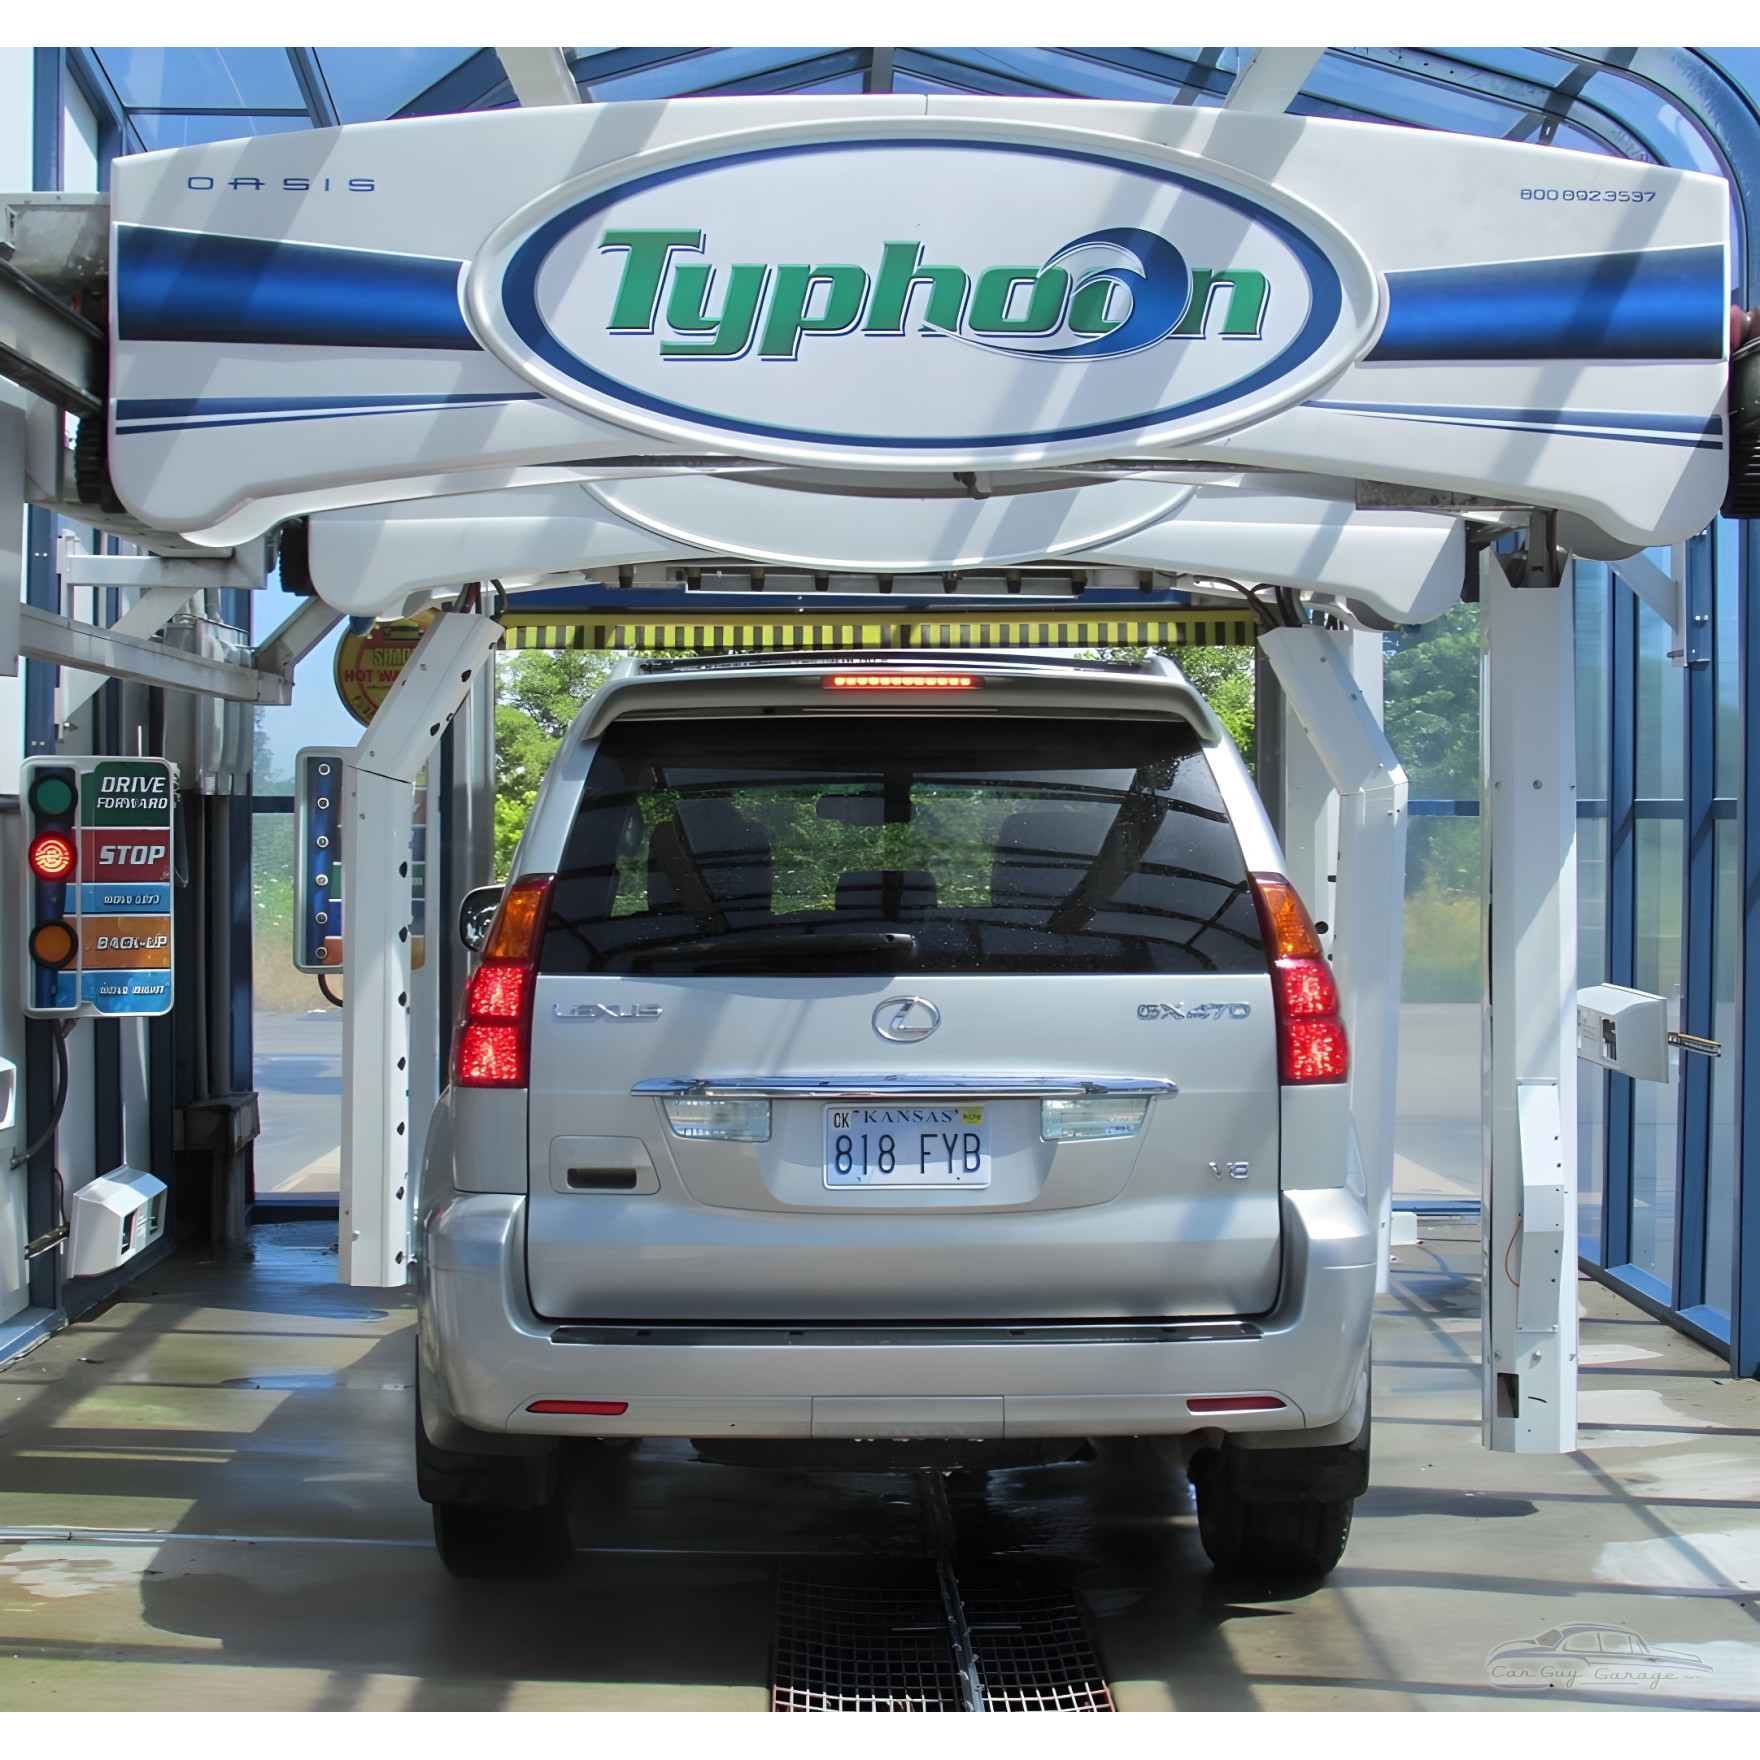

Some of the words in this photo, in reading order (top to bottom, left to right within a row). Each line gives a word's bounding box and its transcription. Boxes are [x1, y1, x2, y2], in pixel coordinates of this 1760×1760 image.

[187, 176, 375, 192] OASIS
[598, 227, 1272, 362] Typhoon
[101, 776, 167, 793] DRIVE
[97, 797, 168, 809] FORWARD
[99, 845, 166, 865] STOP
[551, 1003, 662, 1020] LEXUS
[864, 1110, 953, 1123] KANSAS
[835, 1134, 896, 1176] 818
[920, 1132, 981, 1174] FYB
